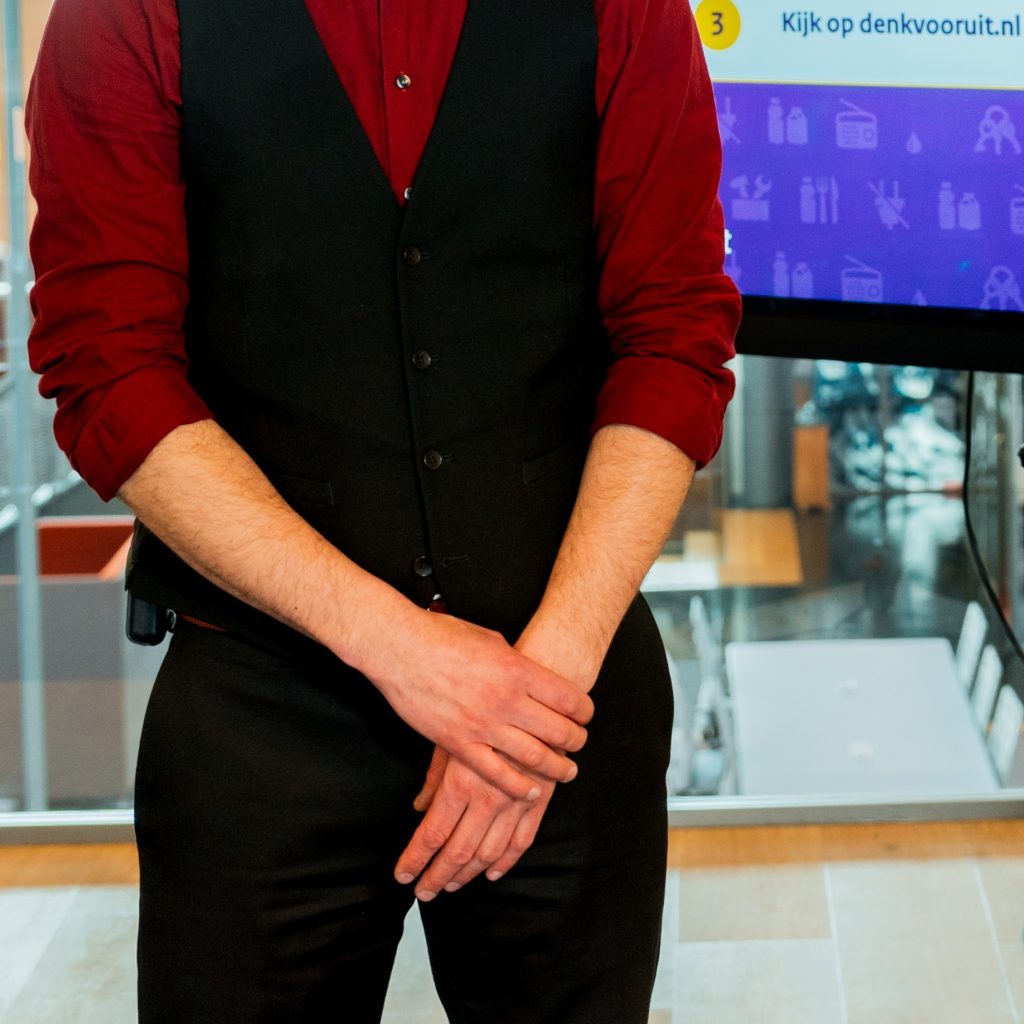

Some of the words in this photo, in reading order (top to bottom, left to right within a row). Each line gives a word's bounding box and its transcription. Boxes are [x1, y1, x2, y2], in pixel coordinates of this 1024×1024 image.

[711, 12, 724, 36] 3
[781, 11, 821, 38] Kijk
[827, 16, 858, 39] op
[860, 12, 1021, 37] denkvooruit.nl
